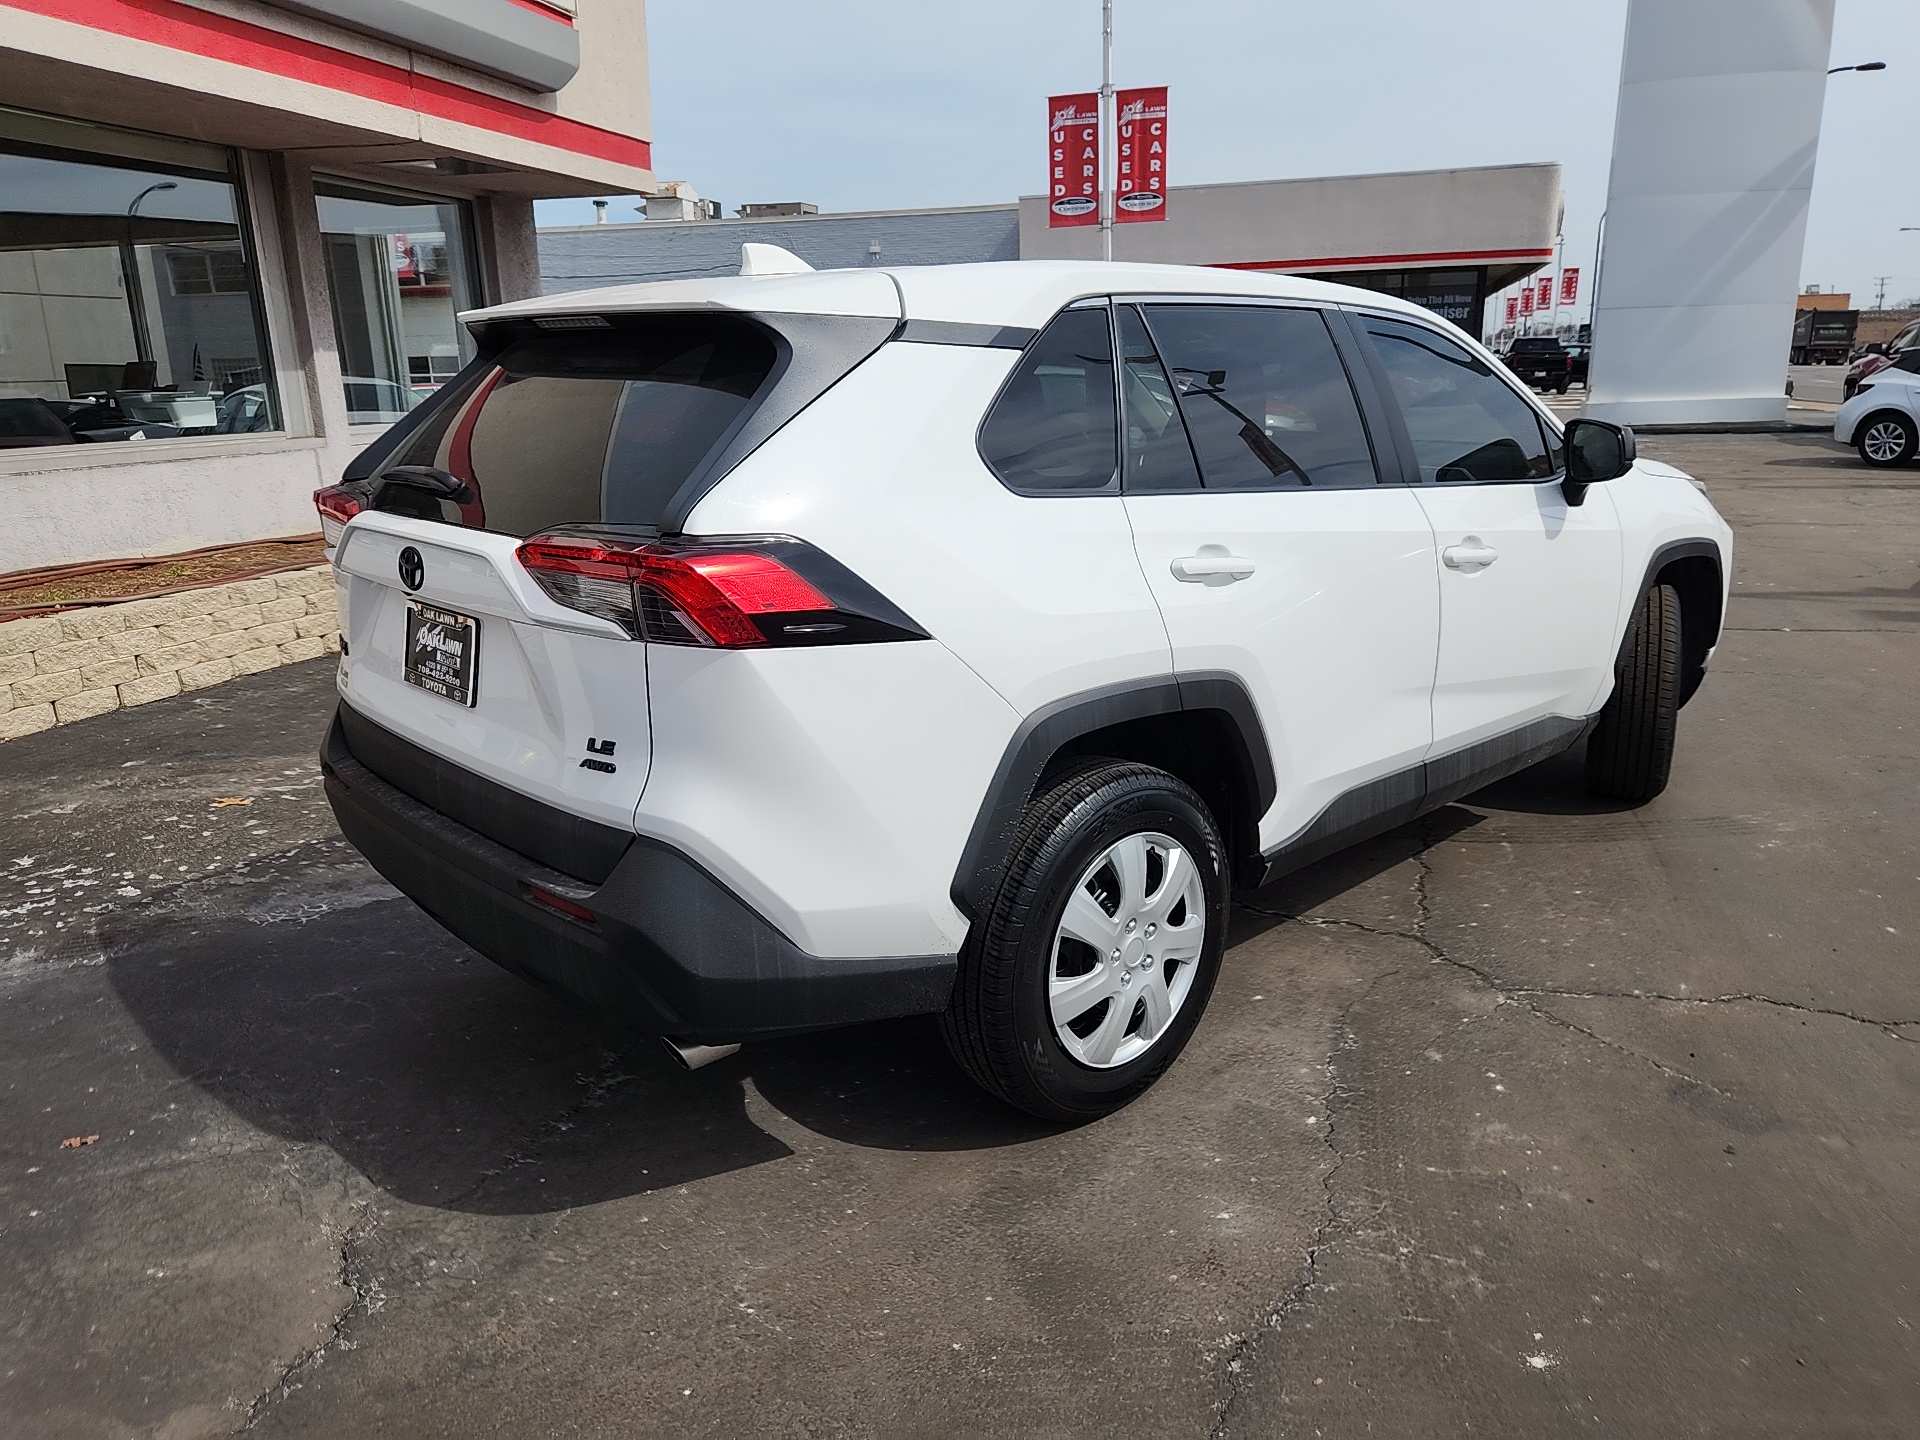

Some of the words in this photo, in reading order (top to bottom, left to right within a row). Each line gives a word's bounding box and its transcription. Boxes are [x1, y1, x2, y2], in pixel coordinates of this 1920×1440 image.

[1054, 131, 1065, 197] USED
[1083, 129, 1094, 195] CARS
[1121, 125, 1132, 191] USED
[1150, 123, 1162, 190] CARS
[1428, 306, 1470, 318] uiser
[423, 608, 436, 621] OAK
[436, 612, 455, 626] LAWN
[422, 677, 447, 695] TOYOTA
[586, 737, 616, 756] LE
[579, 758, 617, 774] AWD
